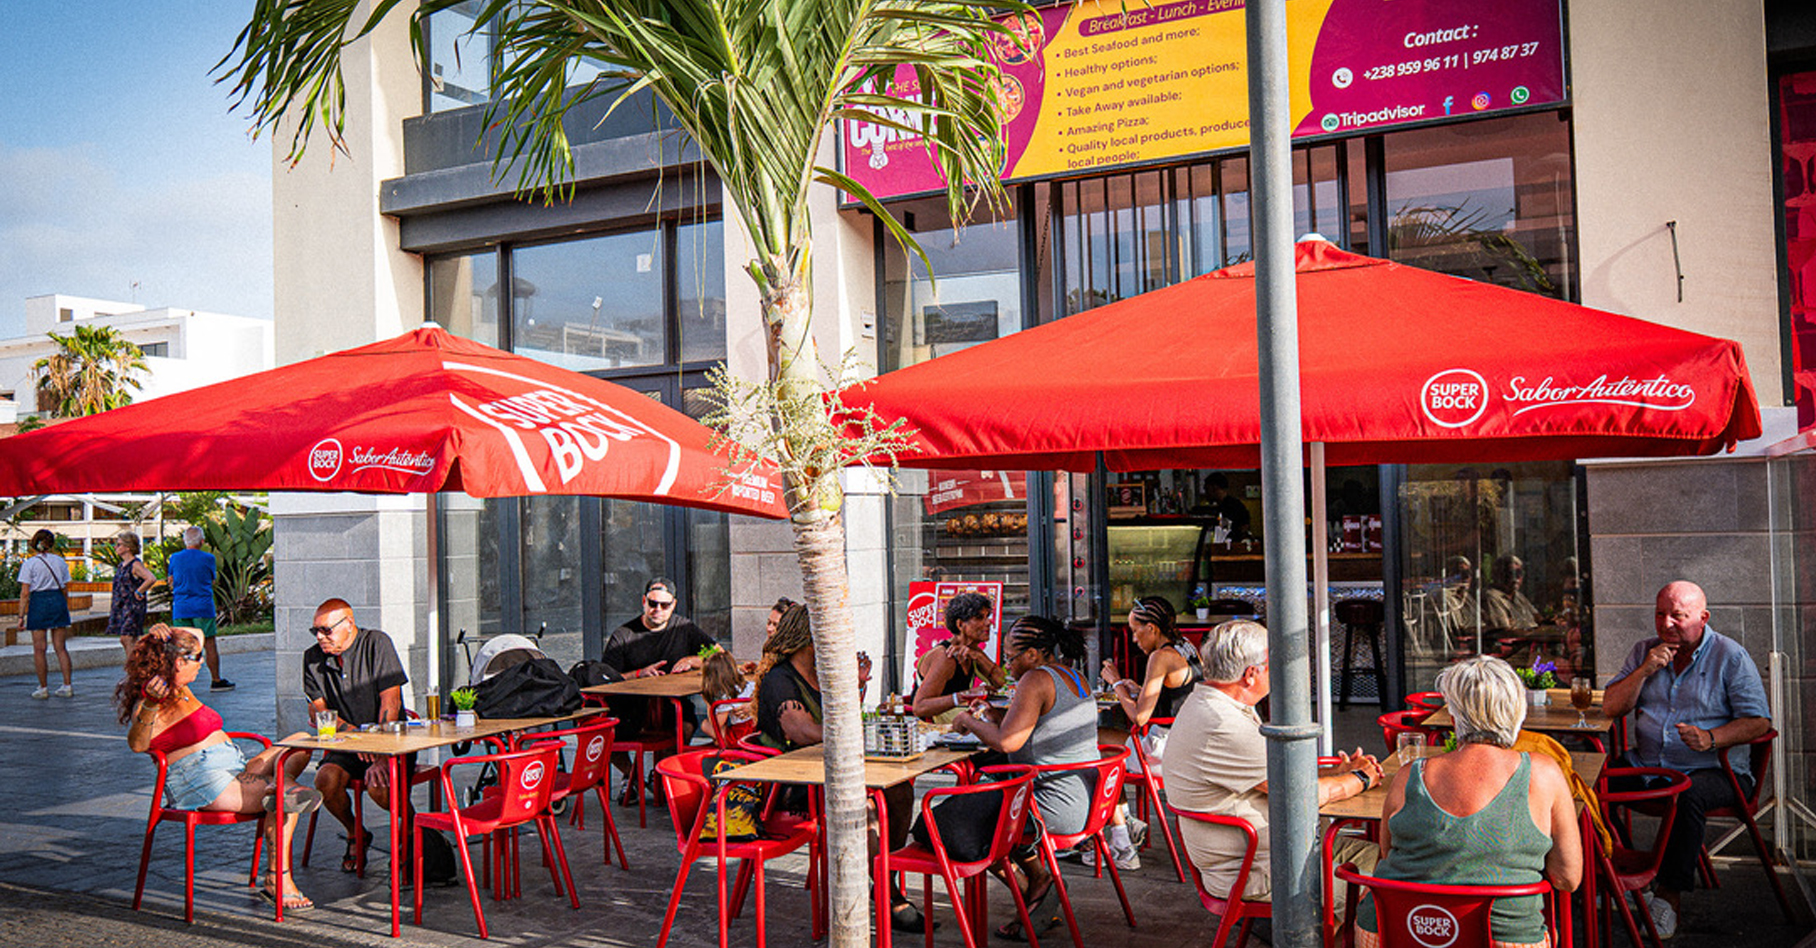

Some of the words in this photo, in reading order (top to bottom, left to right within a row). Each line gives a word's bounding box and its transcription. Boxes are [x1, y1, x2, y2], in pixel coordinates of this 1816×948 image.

[1089, 11, 1148, 33] Breakfast
[1158, 1, 1197, 20] Lunch
[1404, 24, 1470, 48] Contact
[1064, 47, 1089, 59] Best
[1092, 36, 1139, 54] Seafood
[1141, 32, 1163, 46] and
[1363, 64, 1395, 80] +238
[1397, 60, 1422, 77] 959
[1423, 57, 1441, 72] 96
[1443, 54, 1459, 69] 11
[1472, 48, 1499, 65] 974
[1500, 44, 1519, 60] 87
[1520, 41, 1539, 57] 37
[1064, 63, 1108, 78] Healthy
[1065, 86, 1100, 98] Vegan
[1102, 79, 1125, 92] and
[1127, 70, 1189, 89] vegetarian
[1066, 106, 1092, 117] Take
[1094, 102, 1125, 112] Away
[1340, 104, 1426, 127] Tripadvisor
[1066, 121, 1115, 137] Amazing
[1067, 139, 1108, 155] Quality
[1110, 133, 1138, 147] local
[1140, 126, 1198, 145] products,
[1067, 156, 1095, 169] local
[1430, 382, 1480, 396] SUPER
[1503, 376, 1577, 401] Sabor
[478, 389, 594, 430] SUPER
[1431, 396, 1477, 409] BOCK
[313, 450, 339, 461] SUPER
[348, 446, 386, 465] Sabor
[539, 412, 646, 485] BOCK
[313, 459, 336, 469] BOCK
[908, 603, 936, 621] SUPE
[912, 614, 935, 628] BOC
[1413, 915, 1451, 929] SUPER
[1416, 925, 1450, 937] BOCK
